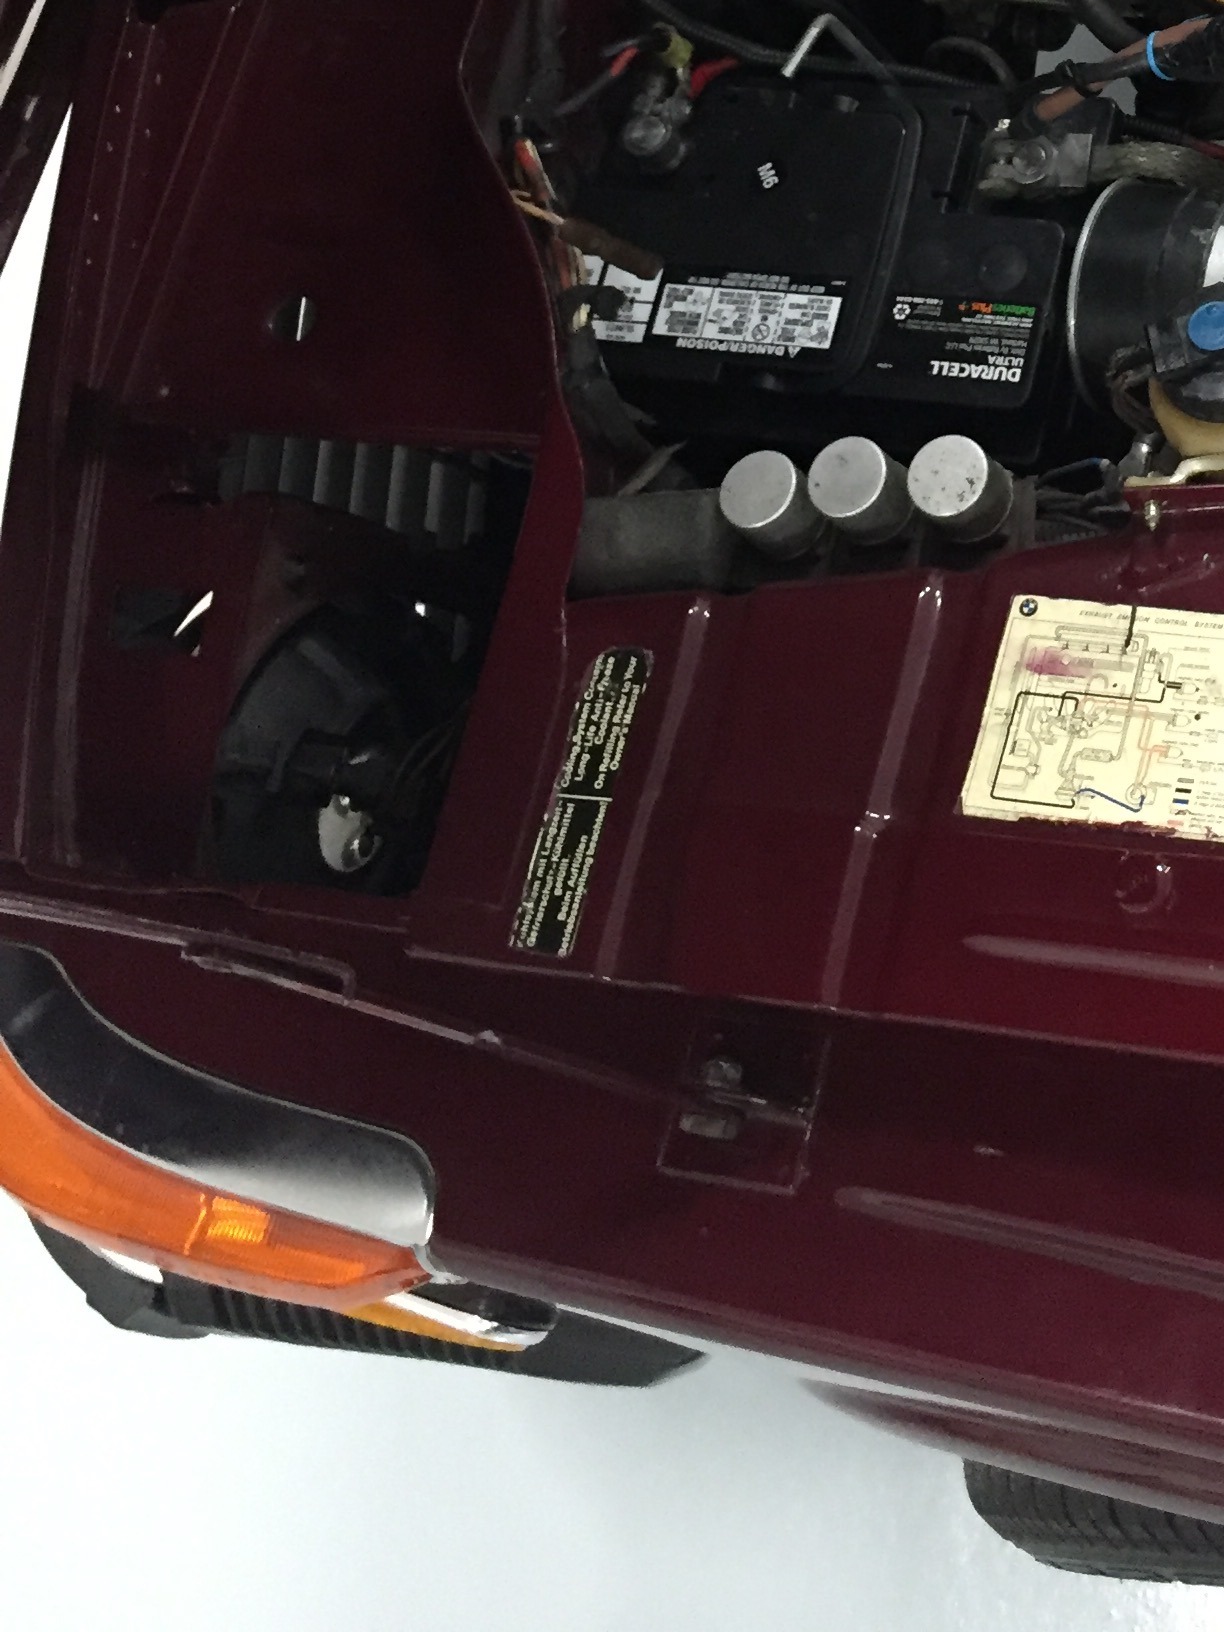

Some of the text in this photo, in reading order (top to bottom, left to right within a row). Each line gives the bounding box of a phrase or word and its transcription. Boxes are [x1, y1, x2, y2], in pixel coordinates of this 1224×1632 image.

[675, 336, 785, 356] DANGER/POISON
[927, 360, 1022, 382] DURACELL
[985, 354, 1024, 366] ULTRA
[1154, 617, 1187, 626] CONTROL
[1194, 621, 1223, 629] SYSTEM
[592, 655, 638, 789] On Refilling Refer to Your
[607, 683, 642, 770] Owner's Manual
[556, 889, 573, 921] Beim
